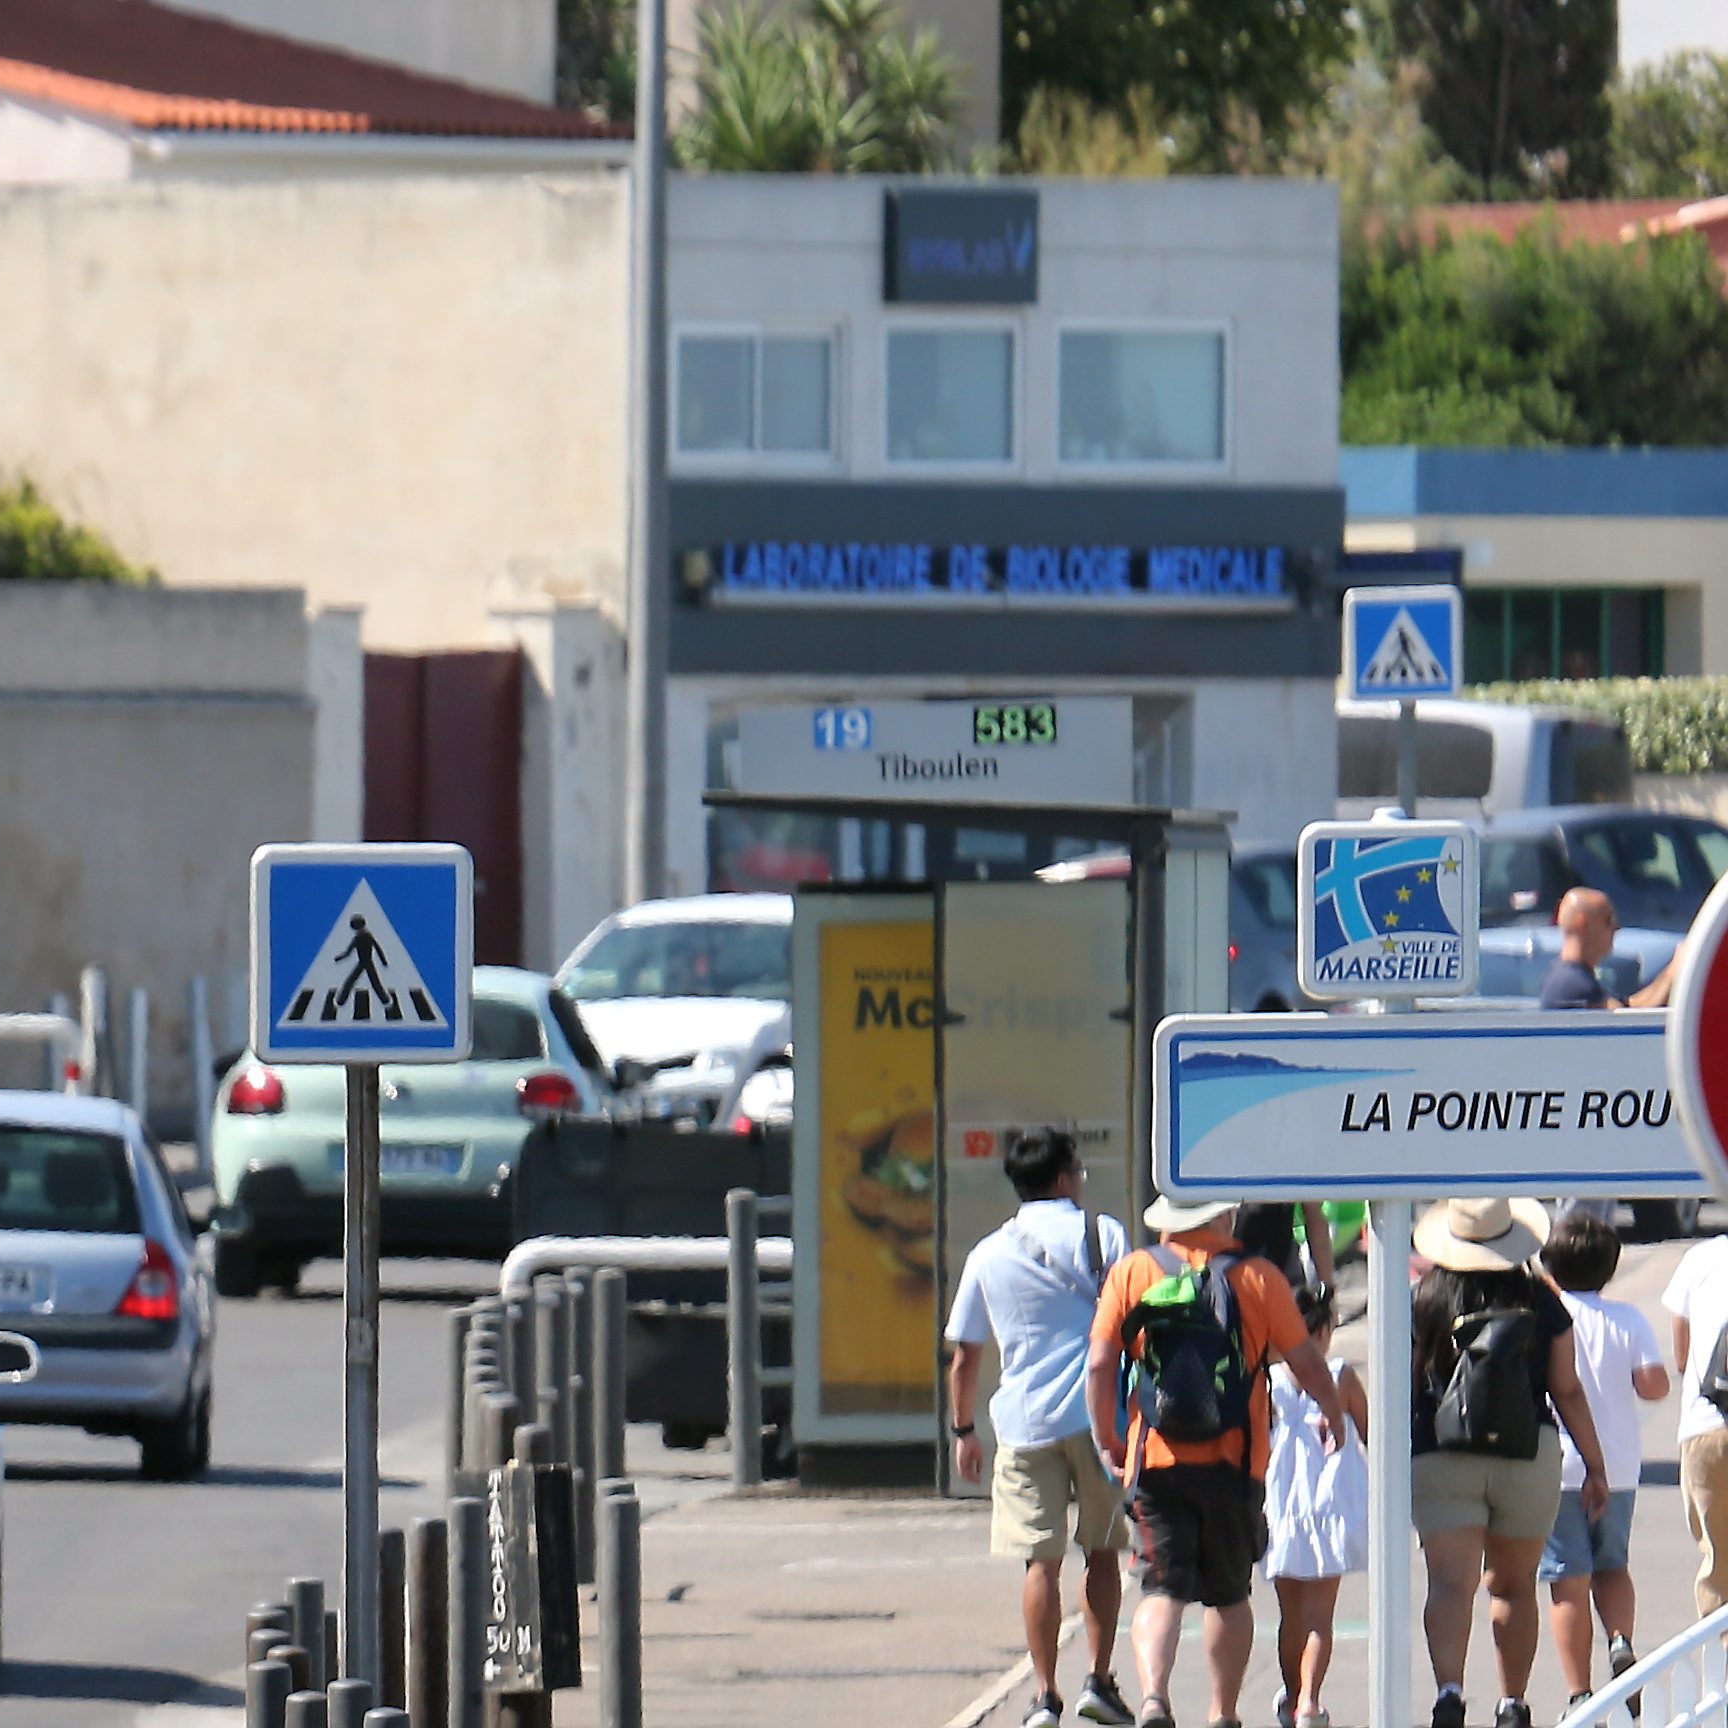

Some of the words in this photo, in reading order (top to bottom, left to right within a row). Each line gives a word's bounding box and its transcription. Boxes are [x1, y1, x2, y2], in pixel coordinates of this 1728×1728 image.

[723, 542, 931, 591] LABORATOIRE
[949, 543, 987, 591] DE
[1006, 544, 1131, 592] BIOLOGIE
[816, 708, 868, 747] 19
[975, 705, 1055, 743] 583
[877, 752, 998, 780] Tiboulen
[1401, 941, 1436, 954] VILLE
[1441, 940, 1460, 953] DE
[1318, 956, 1460, 980] MARSEILLE
[1340, 1091, 1390, 1132] LA
[1407, 1089, 1566, 1131] POINTE
[1578, 1088, 1673, 1129] ROU
